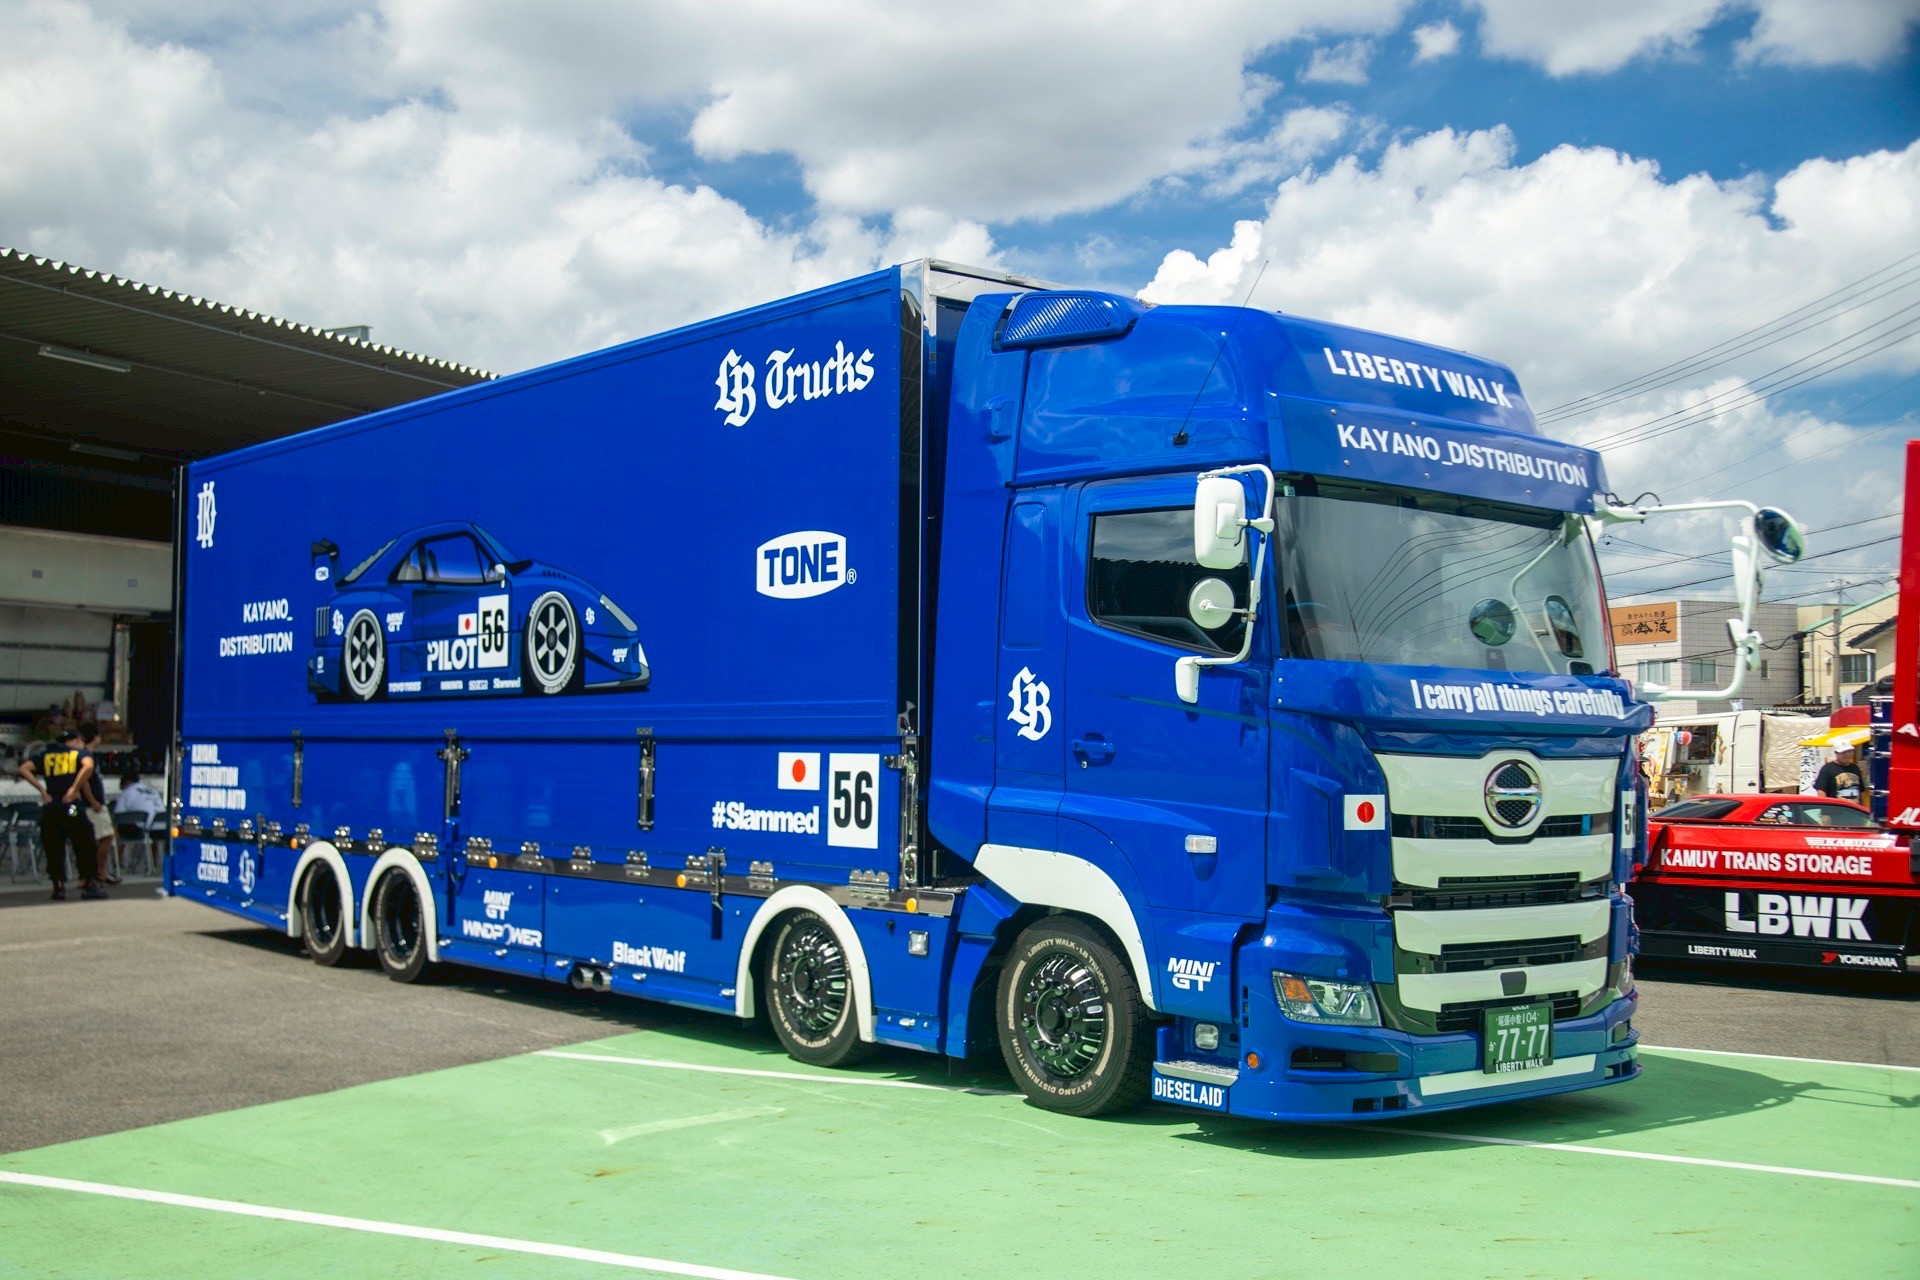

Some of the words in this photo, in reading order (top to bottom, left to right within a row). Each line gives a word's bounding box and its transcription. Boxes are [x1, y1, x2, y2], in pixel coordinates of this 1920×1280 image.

[765, 339, 875, 410] Trucks
[1323, 347, 1442, 393] LIBERTY
[1441, 369, 1513, 409] WALK
[764, 541, 838, 588] TONE
[220, 631, 293, 658] DISTRIBUTION
[481, 607, 505, 653] 56
[426, 639, 478, 672] PILOT
[1410, 679, 1423, 709] I
[1423, 684, 1474, 712] carry
[1473, 683, 1499, 712] all
[1497, 684, 1554, 717] things
[1554, 689, 1625, 720] carefully
[44, 749, 79, 777] FBI
[834, 771, 873, 829] 56
[712, 800, 820, 835] #Slammed
[1661, 848, 1718, 869] KAMUY
[1722, 850, 1782, 872] TRANS
[1785, 854, 1873, 876] STORAGE
[482, 889, 511, 907] MINI
[486, 905, 510, 920] GT
[1724, 892, 1872, 941] LBWK
[462, 919, 543, 948] WINDPOWER
[1028, 938, 1054, 957] LIBERTY
[1055, 937, 1076, 950] WALK
[1088, 955, 1109, 994] TRUCKS
[1688, 944, 1729, 957] LIBERTY
[1728, 947, 1757, 959] WALK
[1838, 954, 1898, 968] YOKOHAMA
[1167, 956, 1216, 977] MINI
[1172, 974, 1212, 992] GT
[1011, 1037, 1057, 1094] DISTRIBUTION
[1496, 1060, 1524, 1074] LIBERTY
[1525, 1057, 1544, 1070] WALK
[1058, 1079, 1093, 1096] KAYANO
